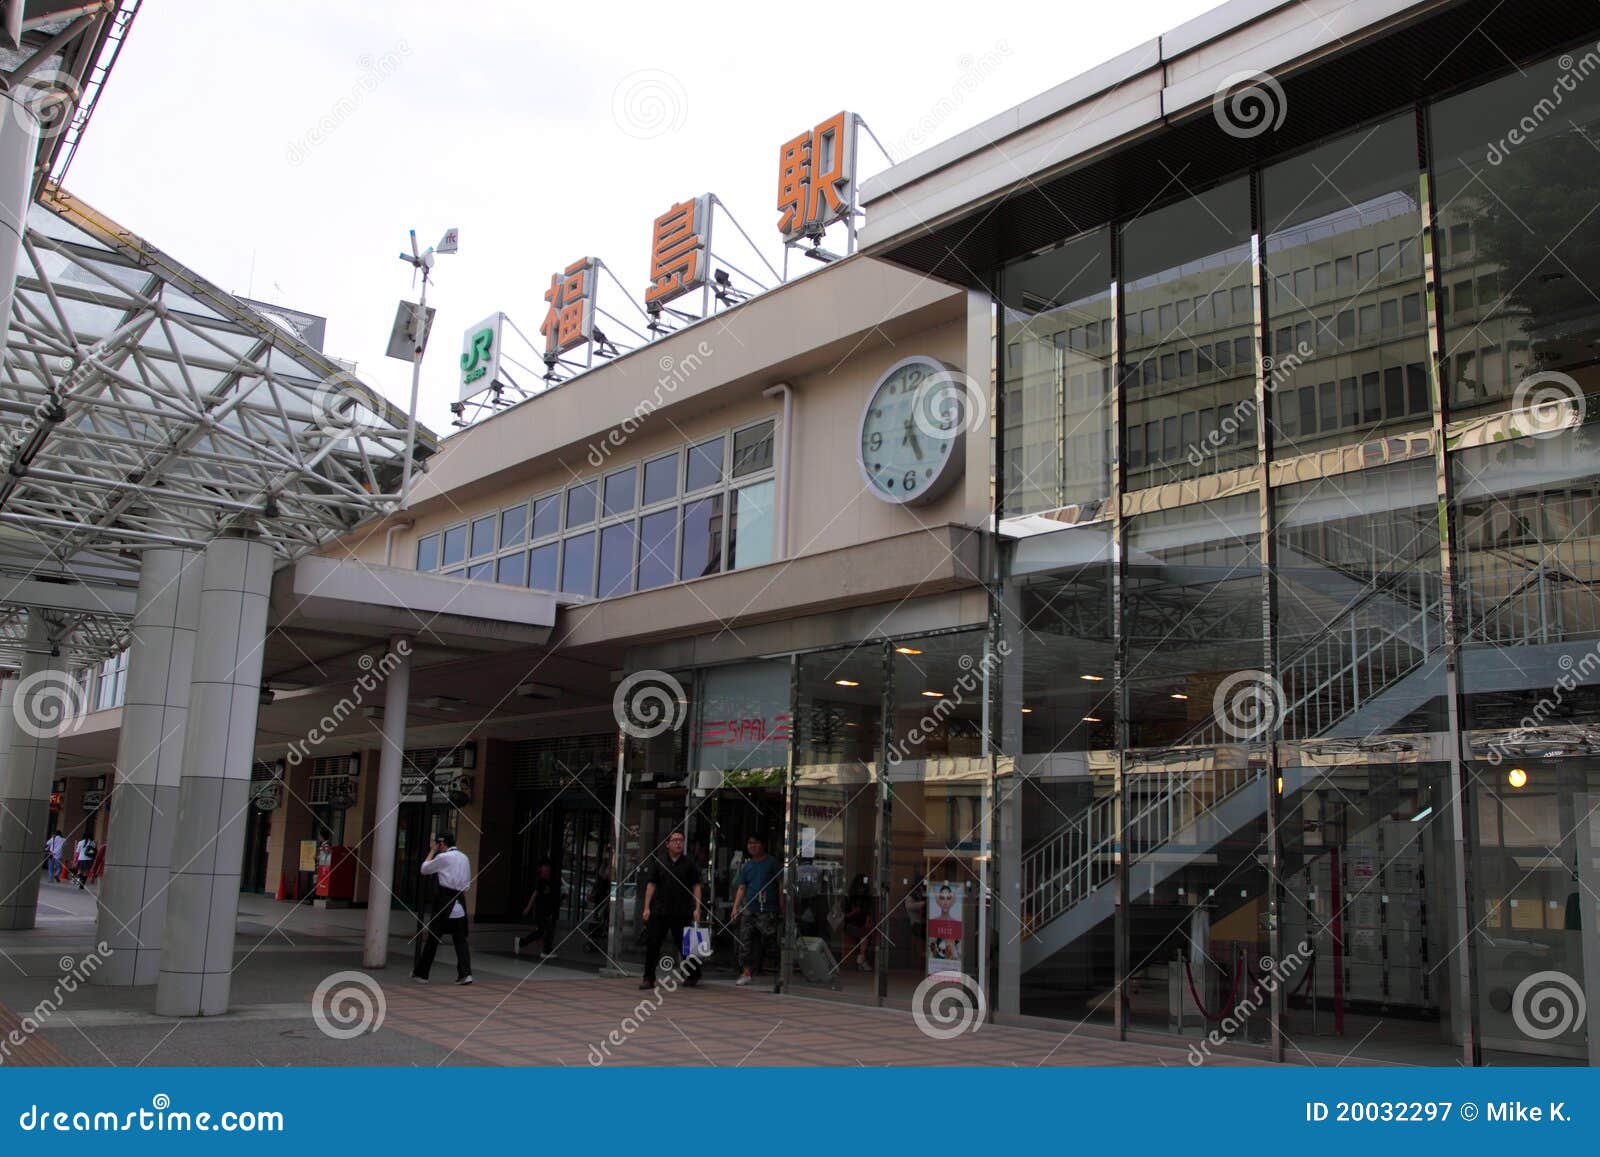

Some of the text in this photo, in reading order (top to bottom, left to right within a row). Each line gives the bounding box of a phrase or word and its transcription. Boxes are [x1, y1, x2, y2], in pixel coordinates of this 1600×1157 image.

[460, 327, 493, 371] JR
[901, 370, 923, 394] 12
[870, 432, 883, 452] 9
[902, 470, 917, 491] 6
